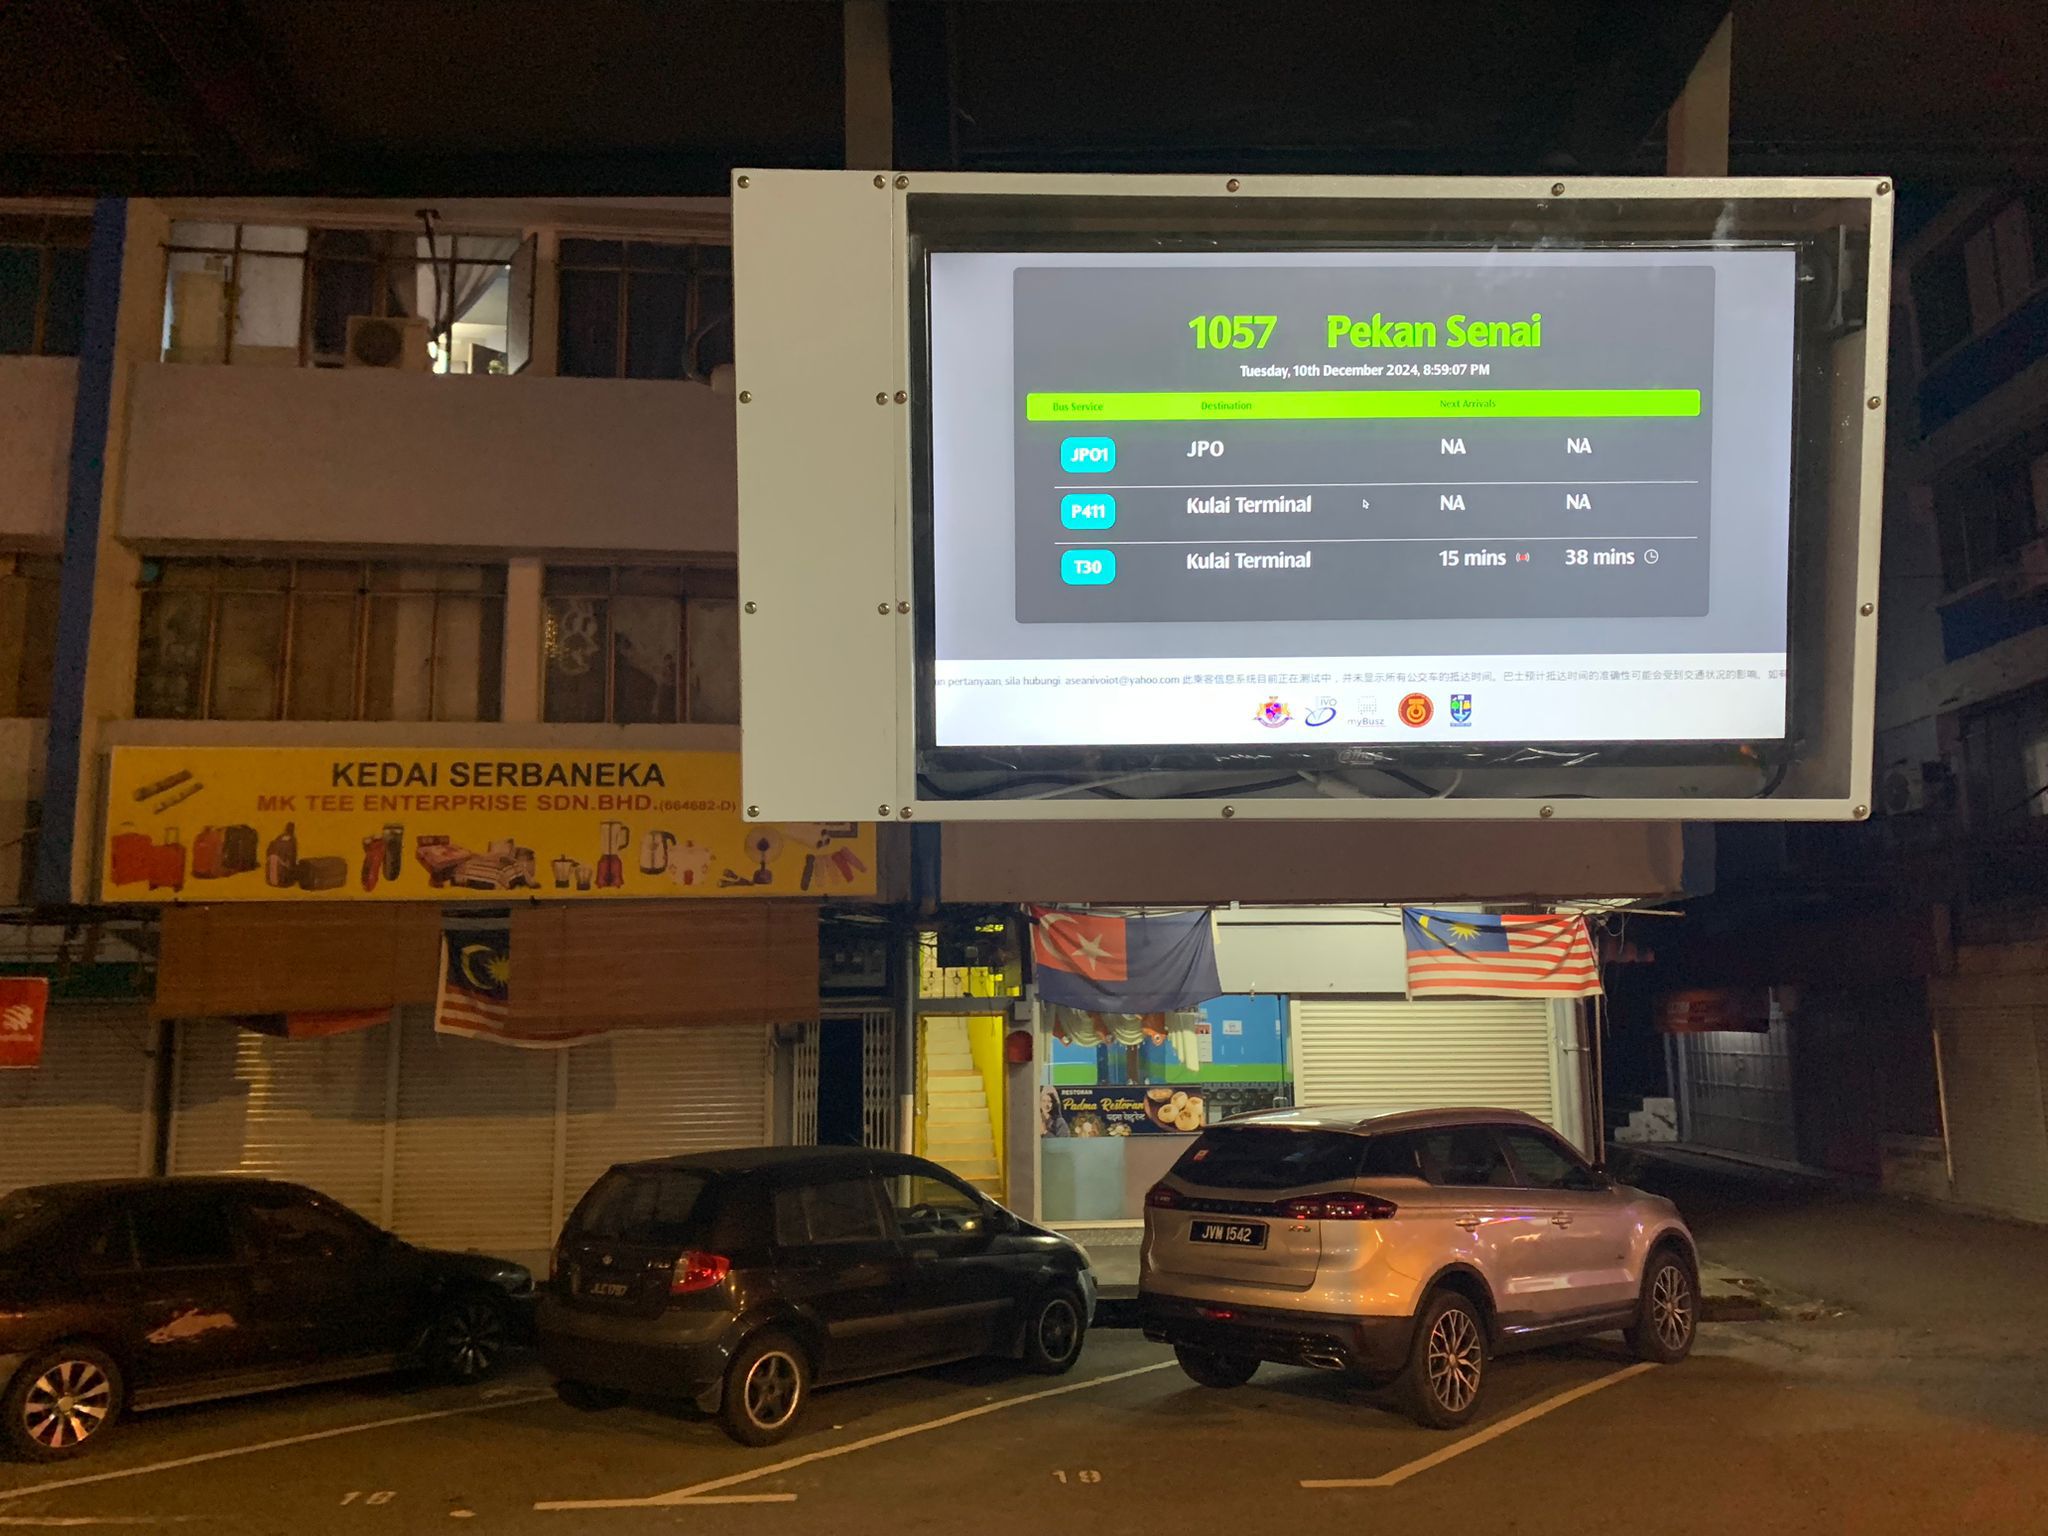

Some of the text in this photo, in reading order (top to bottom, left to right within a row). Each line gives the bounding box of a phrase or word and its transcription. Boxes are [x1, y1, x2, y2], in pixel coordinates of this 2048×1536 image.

[1188, 312, 1542, 350] 1057 Pekan Senai
[1239, 363, 1490, 380] Tuesday, 10th December 2024, 8:59:07 PM
[1052, 401, 1103, 412] Bus Service
[1201, 400, 1252, 411] Destination
[1440, 398, 1496, 409] Next Arrivals
[1186, 440, 1225, 458] JPO
[1441, 438, 1467, 455] NA
[1567, 437, 1593, 454] NA
[1186, 495, 1312, 514] Kulai Terminal
[1440, 494, 1466, 511] NA
[1566, 493, 1592, 510] NA
[1071, 503, 1106, 519] P411
[1186, 551, 1312, 570] Kulai Terminal
[1438, 548, 1507, 567] 15 mins
[1565, 548, 1635, 566] 38 mins
[1074, 559, 1103, 575] T30
[1005, 675, 1021, 686] sila
[332, 761, 666, 788] KEDAI SERBANEKA
[257, 795, 296, 812] MK
[305, 795, 354, 812] TEE
[363, 794, 527, 811] ENTERPRISE
[1062, 1097, 1144, 1111] Padma Restoran
[1201, 1225, 1252, 1243] JVM 1542
